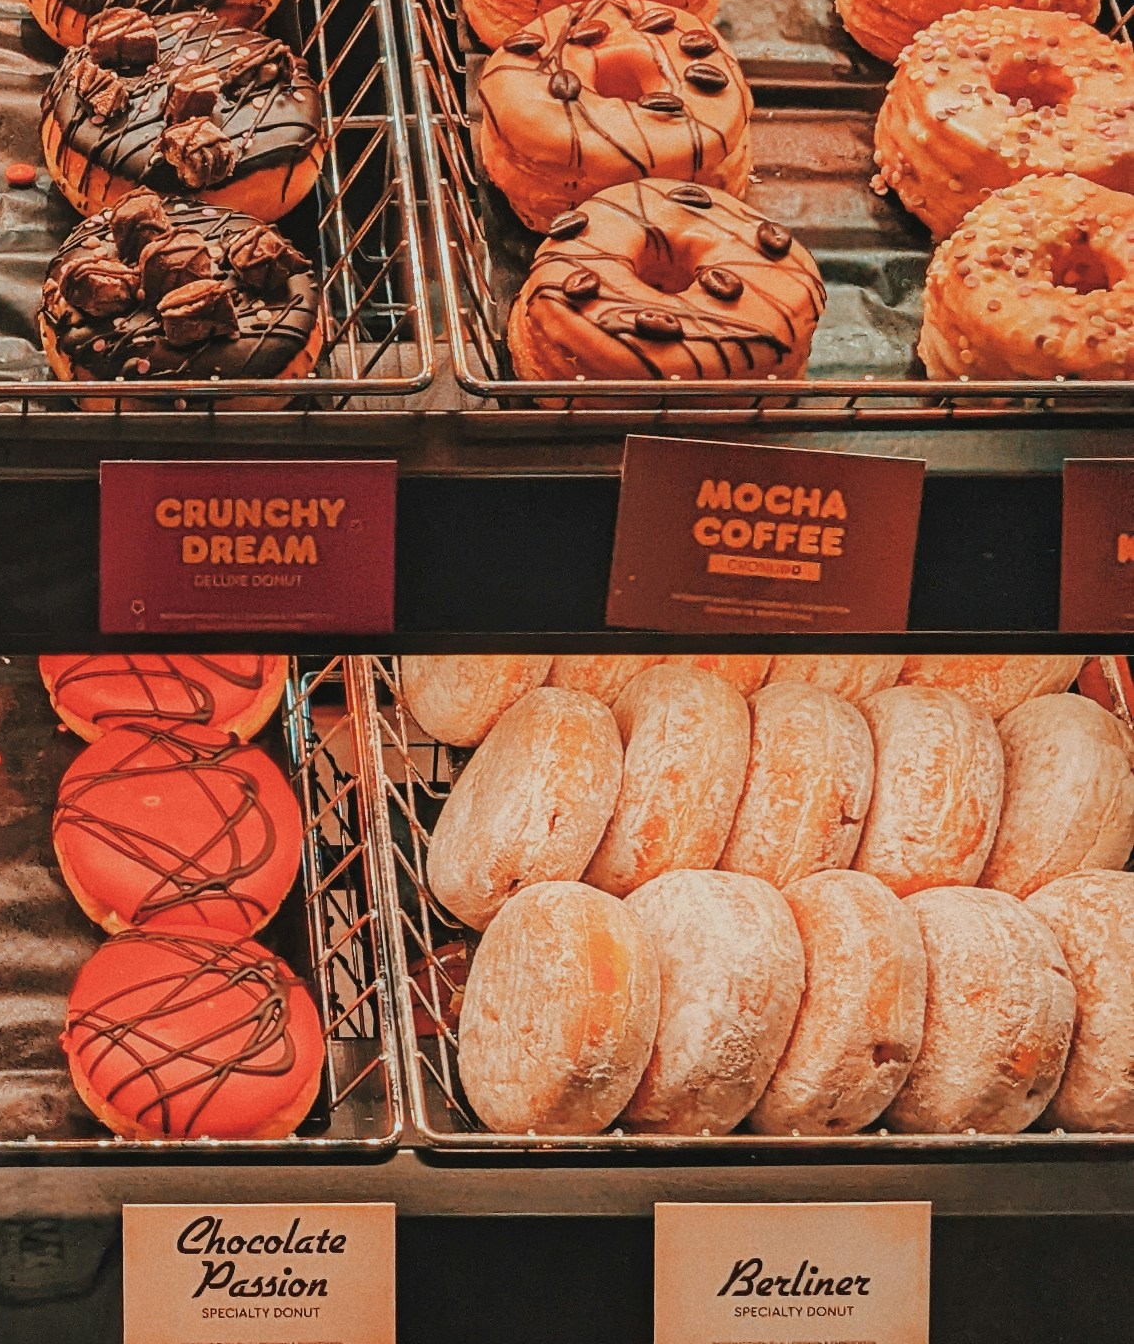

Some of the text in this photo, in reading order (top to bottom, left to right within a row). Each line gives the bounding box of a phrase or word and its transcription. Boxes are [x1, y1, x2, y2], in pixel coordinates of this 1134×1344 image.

[155, 498, 346, 528] CRUNCHY
[696, 479, 848, 520] MOCHA
[182, 535, 318, 565] DREAM
[693, 516, 845, 557] COFFEE
[194, 574, 302, 587] DELUXE DONUT
[176, 1215, 347, 1254] Chocolate
[192, 1260, 328, 1299] Passion
[716, 1257, 871, 1297] Berliner
[202, 1307, 321, 1319] SPECIALTY DONUT
[734, 1306, 854, 1318] SPECIALTY DONUT
